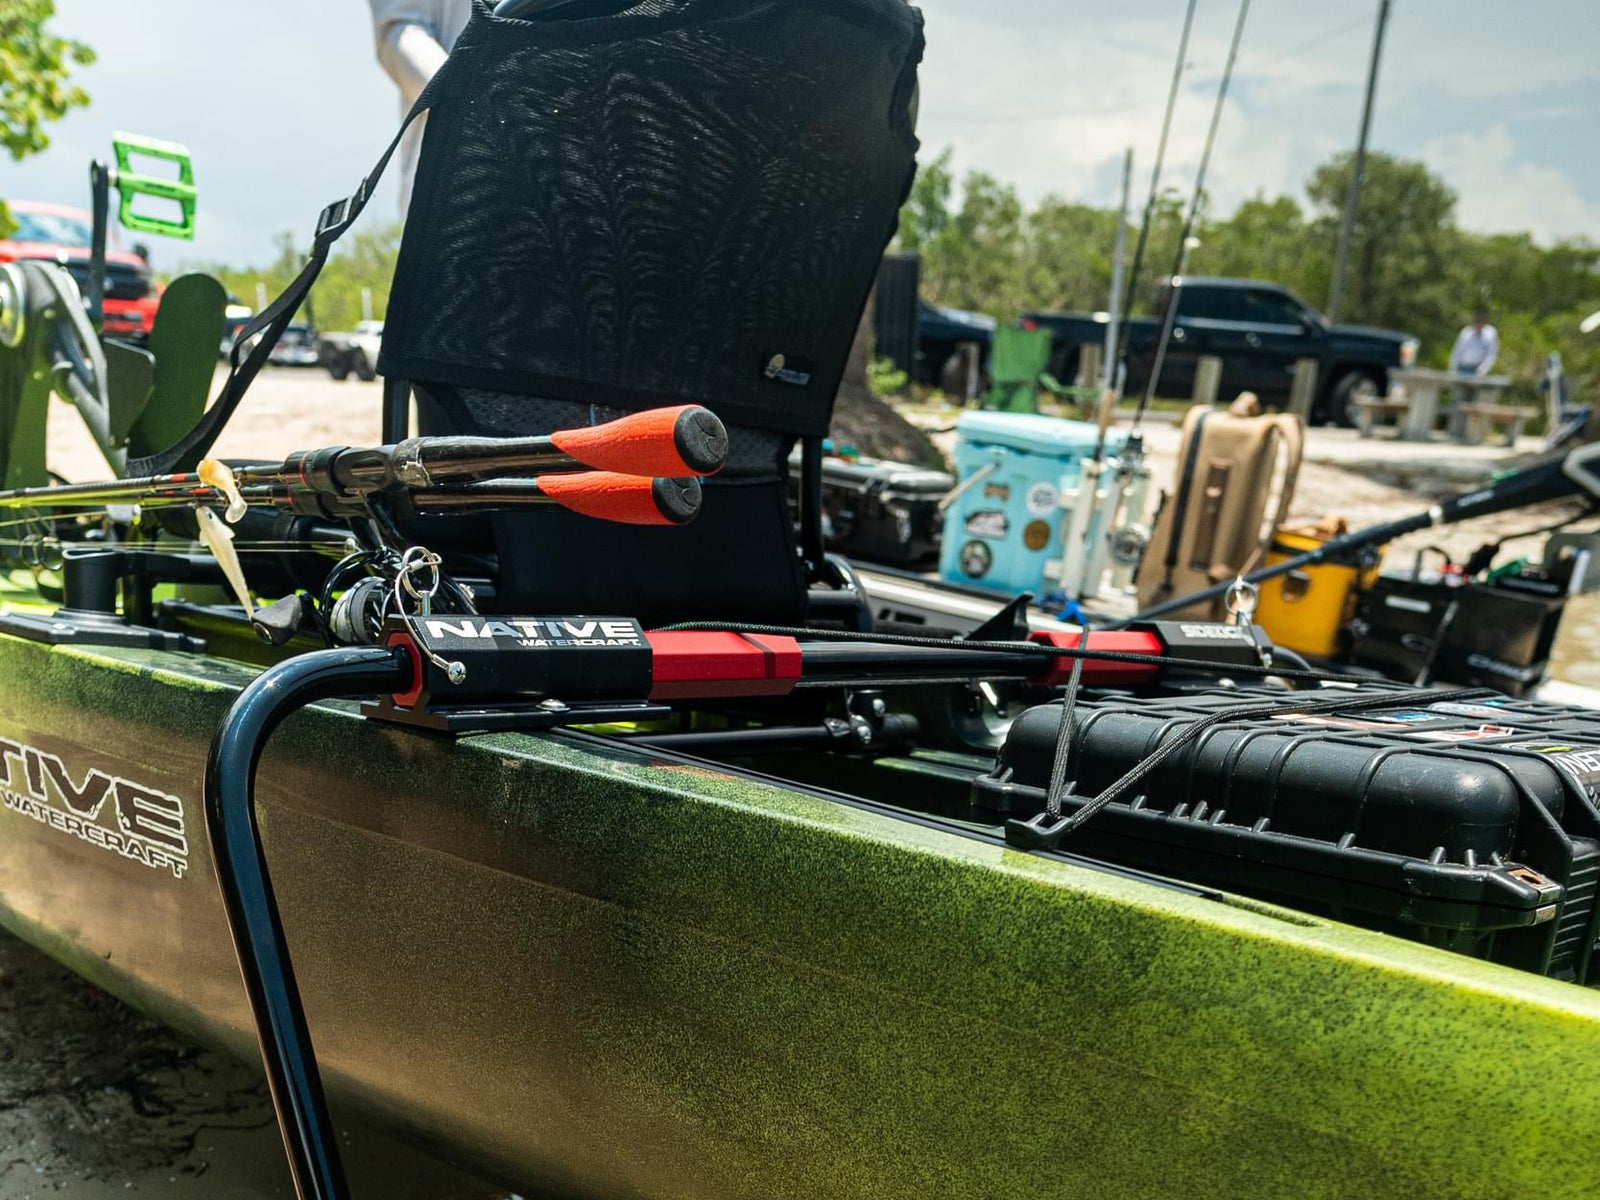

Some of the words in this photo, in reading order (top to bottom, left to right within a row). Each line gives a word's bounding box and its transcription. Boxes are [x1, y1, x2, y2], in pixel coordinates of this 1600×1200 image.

[425, 620, 639, 638] NATIVE
[517, 639, 642, 647] WATERCRAFT
[0, 788, 188, 878] WATERCRAFT
